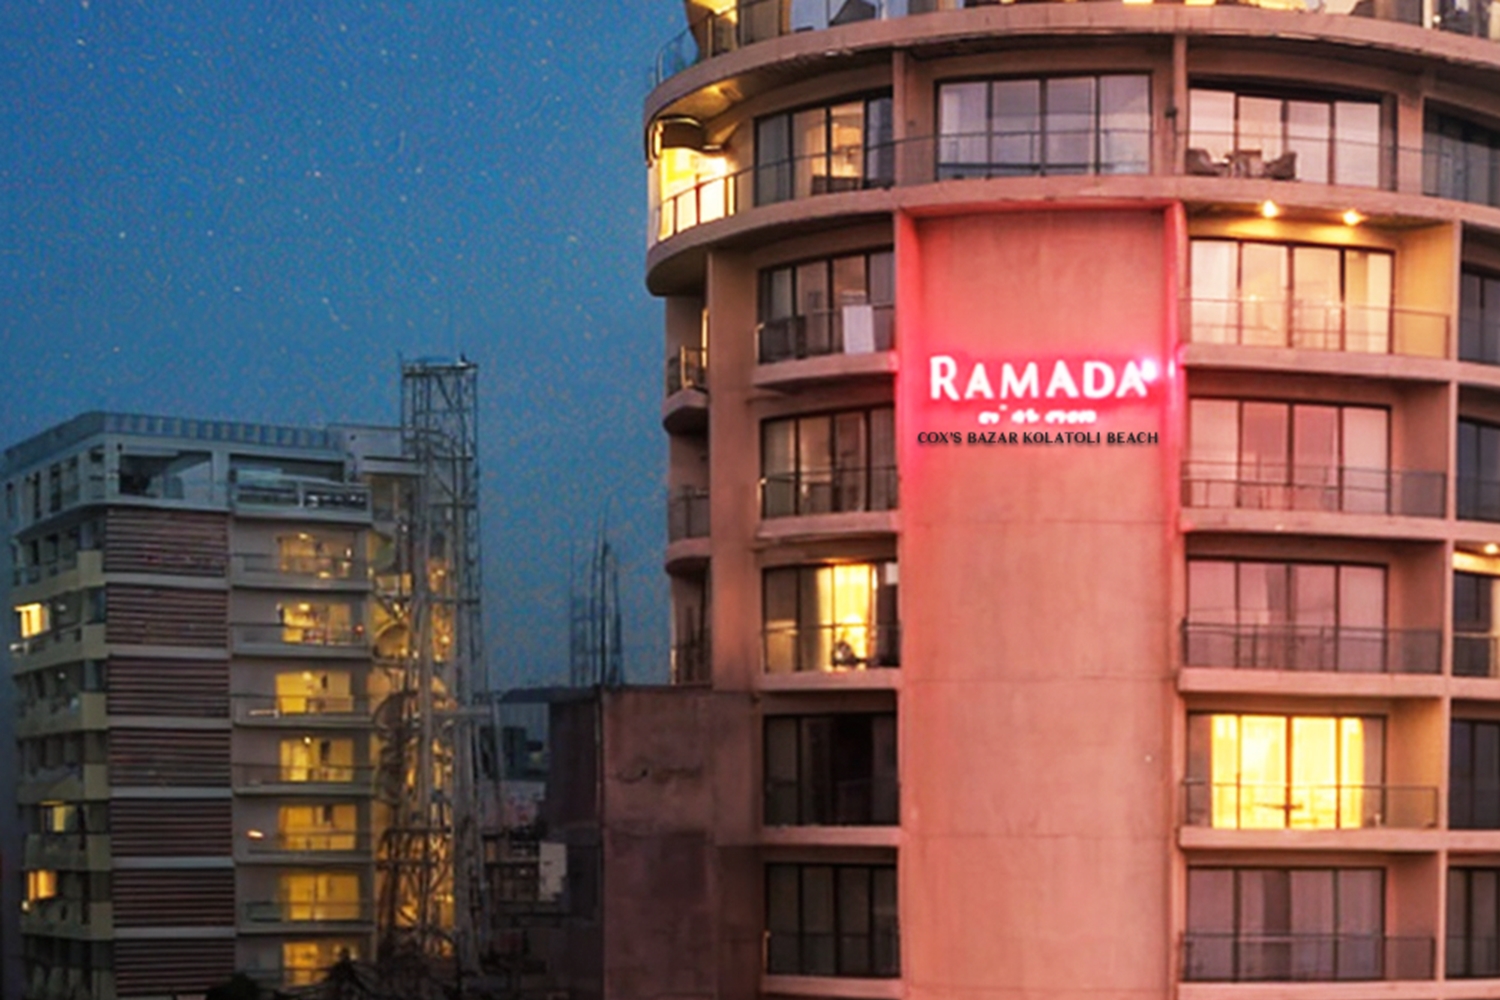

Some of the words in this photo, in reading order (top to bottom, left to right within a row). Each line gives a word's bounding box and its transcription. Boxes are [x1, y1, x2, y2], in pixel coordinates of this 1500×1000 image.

[929, 355, 1149, 401] RAMADA
[917, 431, 962, 444] COX'S
[967, 431, 1018, 444] BAZAR
[1023, 431, 1101, 444] KOLATOLI
[1107, 431, 1159, 444] BEACH
